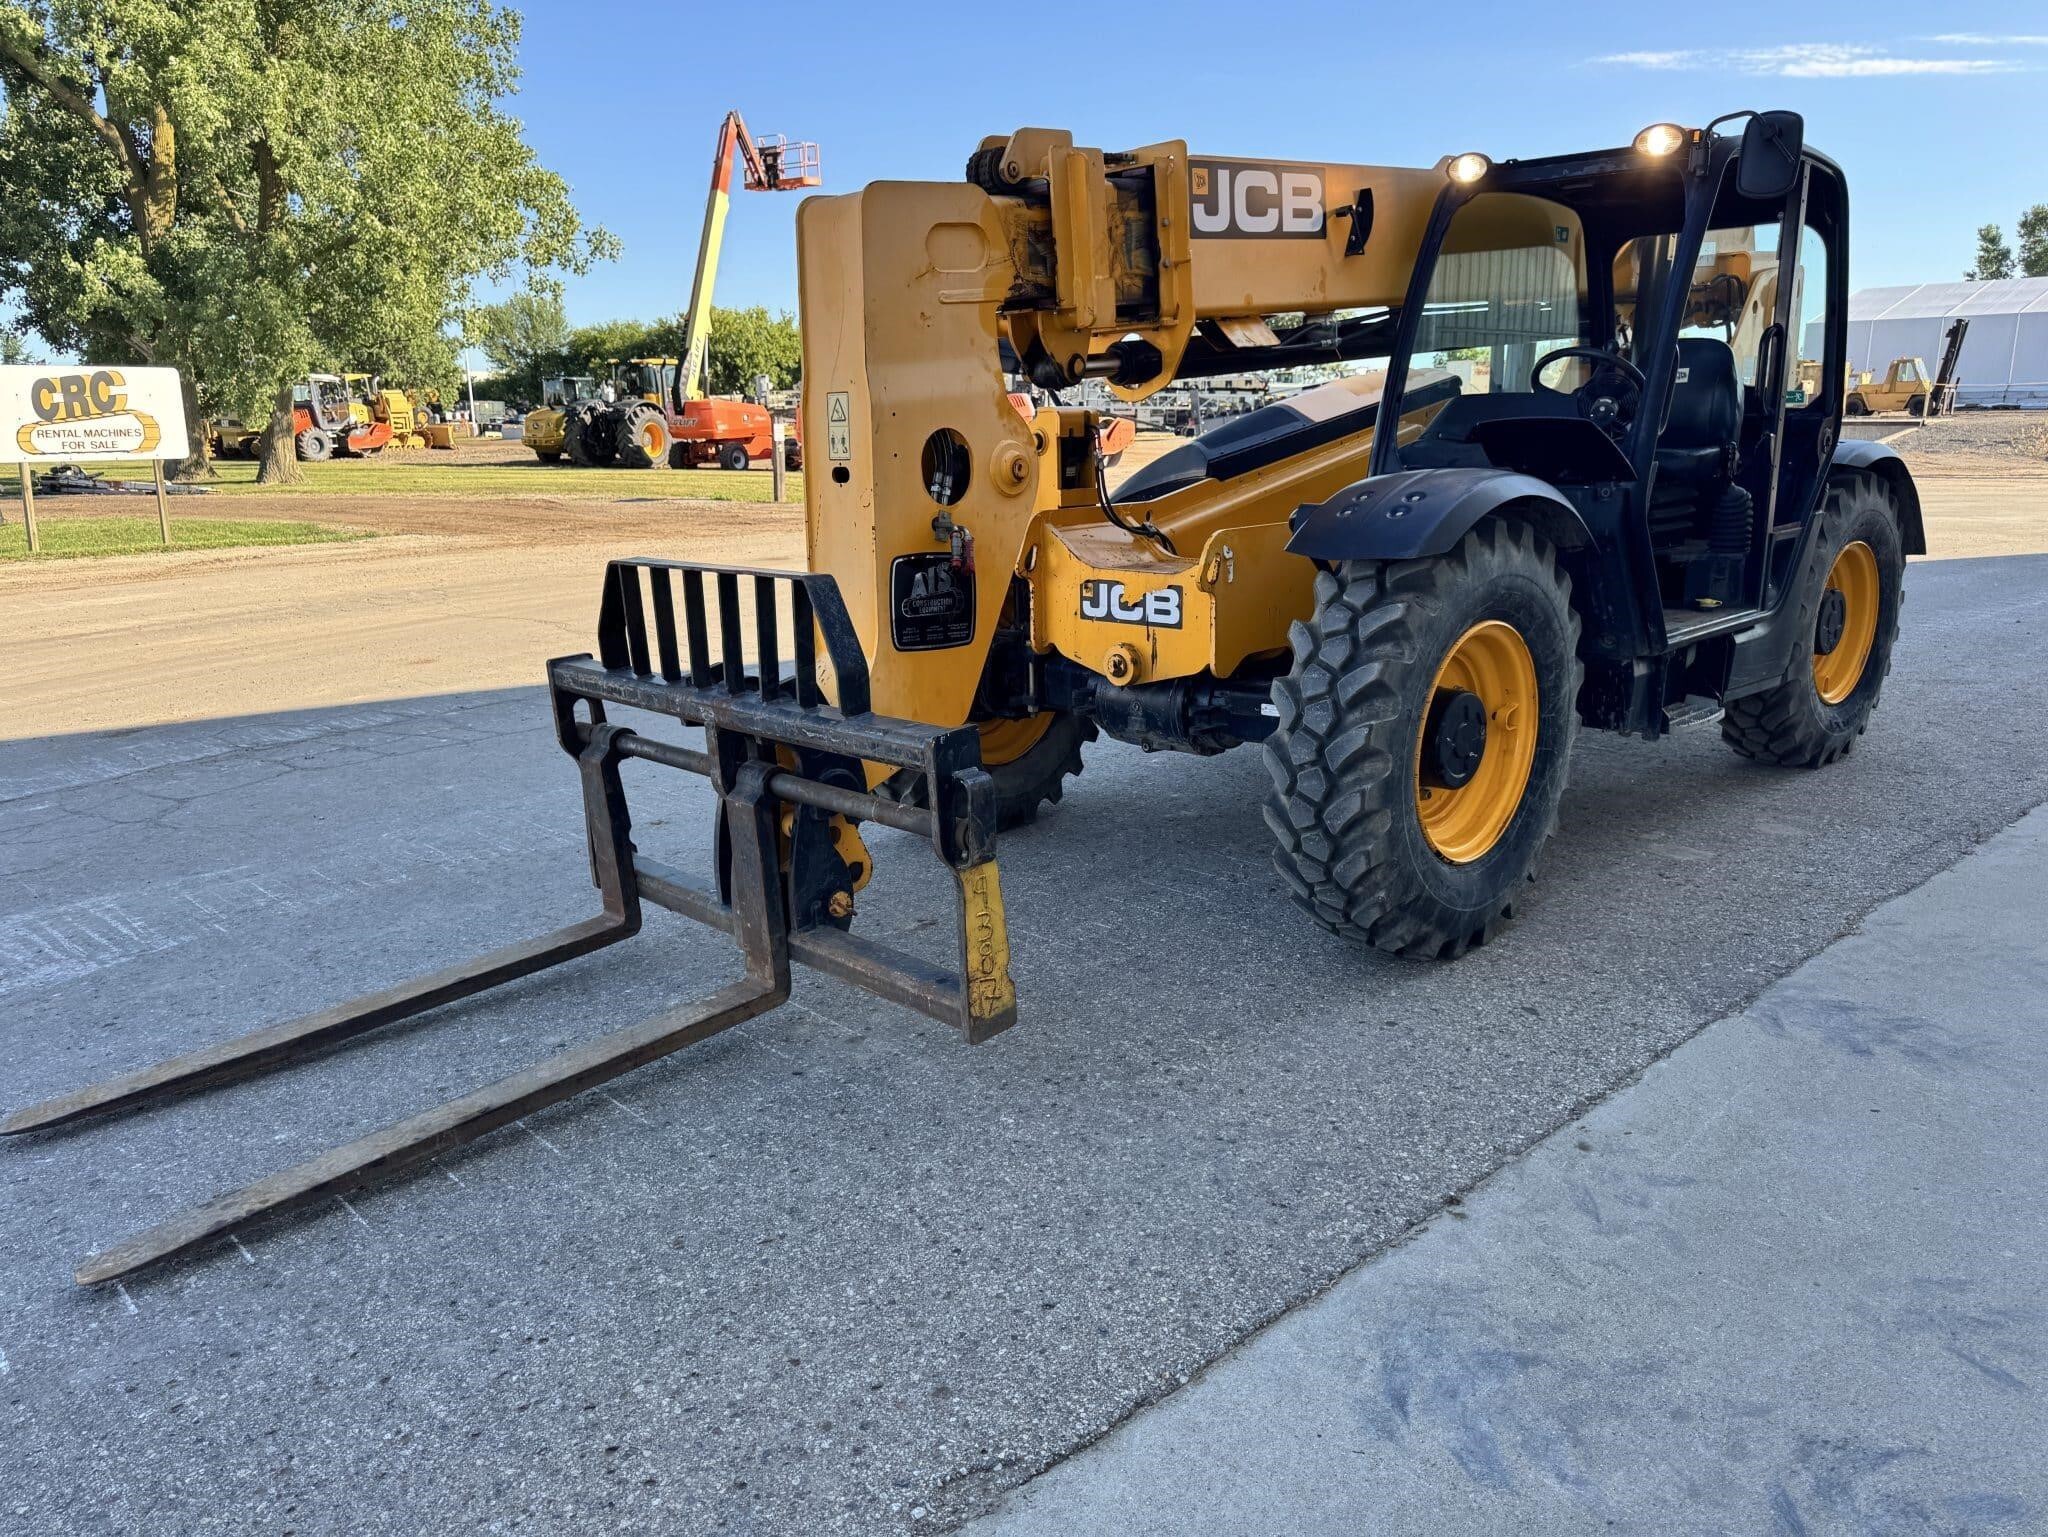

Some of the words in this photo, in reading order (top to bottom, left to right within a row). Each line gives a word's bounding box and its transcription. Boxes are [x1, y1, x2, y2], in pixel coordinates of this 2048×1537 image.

[1193, 169, 1324, 232] JCB
[31, 370, 121, 421] CRC
[36, 429, 81, 439] RENTAL
[83, 428, 142, 438] MACHINES
[61, 441, 86, 450] FOR
[90, 441, 118, 449] SALE
[1082, 583, 1181, 625] JCB
